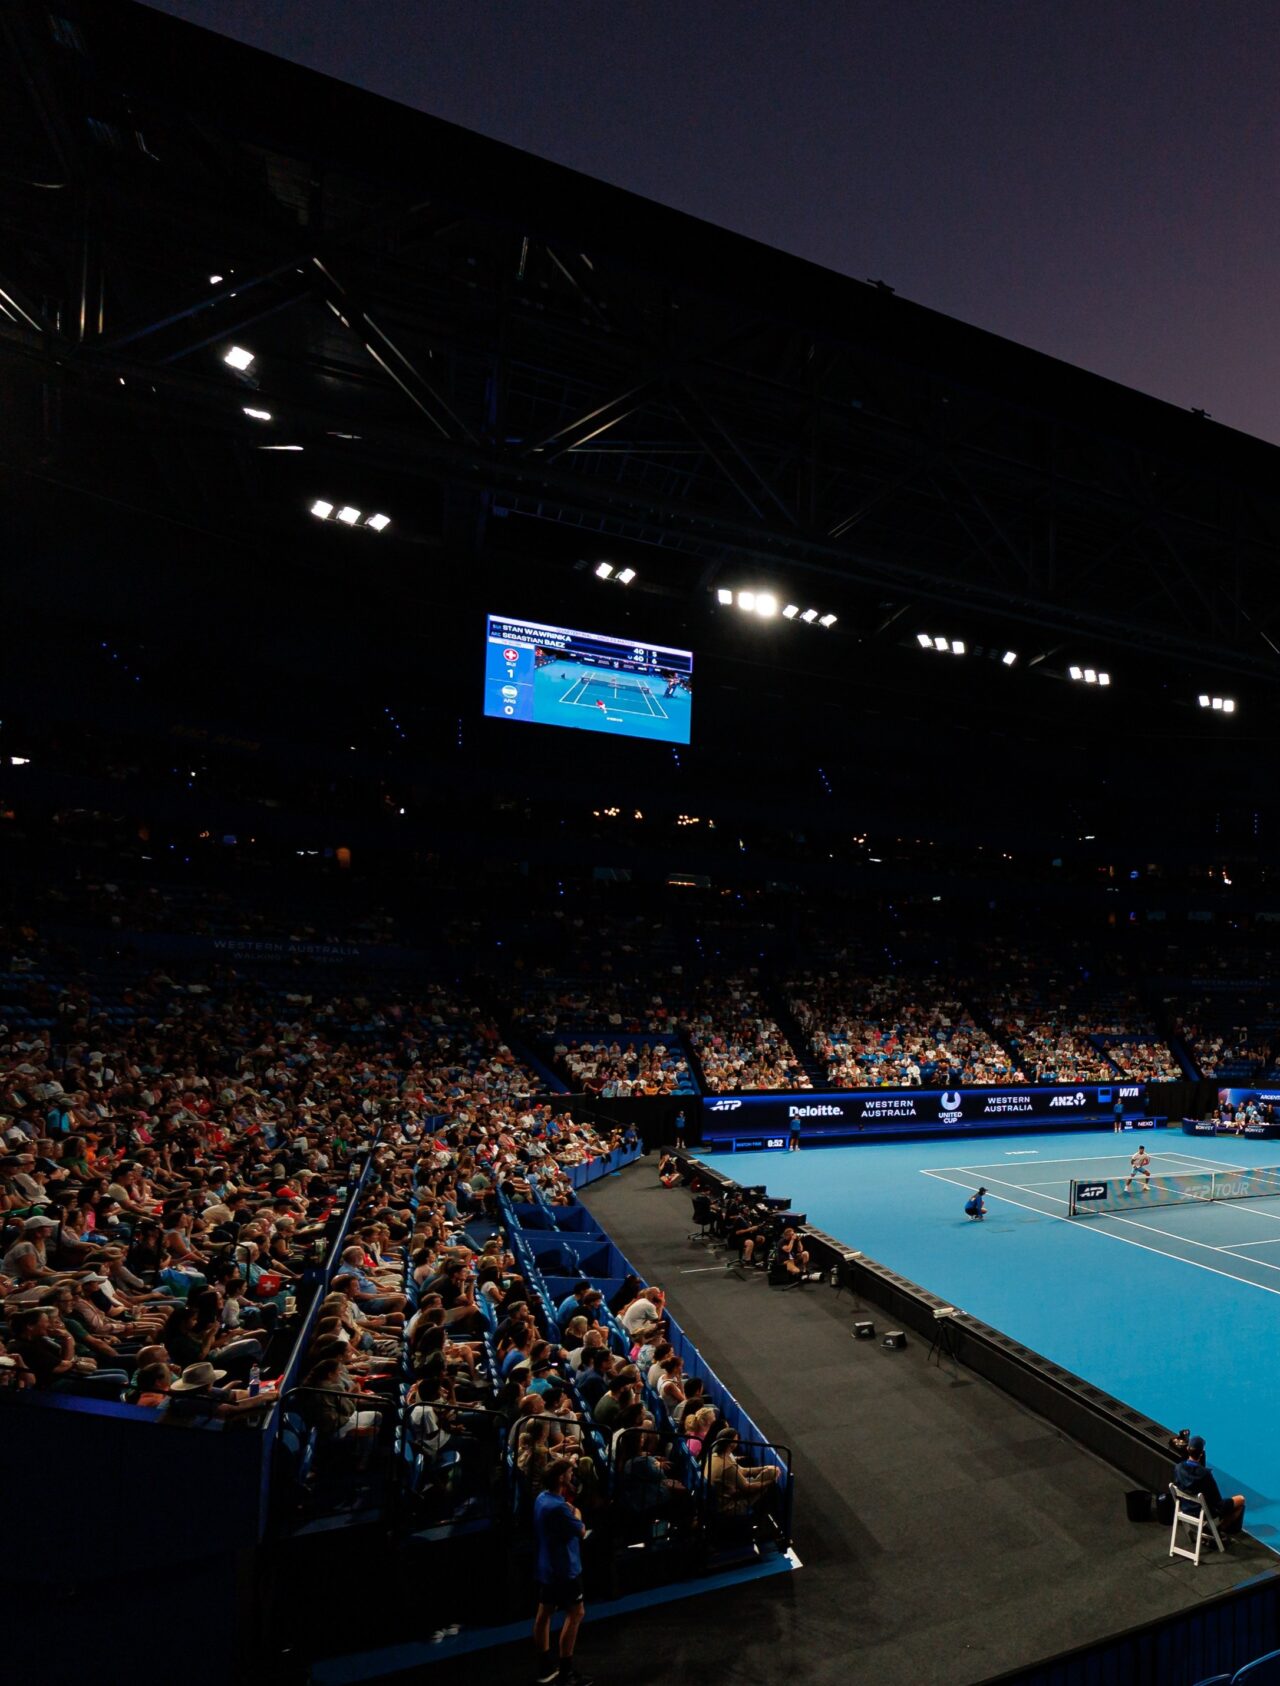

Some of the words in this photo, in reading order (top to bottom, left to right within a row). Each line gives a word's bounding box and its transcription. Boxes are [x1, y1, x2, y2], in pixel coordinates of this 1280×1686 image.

[502, 624, 524, 635] STAN
[524, 628, 572, 643] WAWRINKA
[502, 632, 544, 645] SEBASTIAN
[544, 639, 566, 649] BAEZ
[633, 647, 645, 656] 40
[633, 654, 645, 663] 40
[506, 669, 514, 679] 1
[504, 705, 514, 715] 0
[1119, 1087, 1139, 1097] WTA
[865, 1100, 914, 1109] WESTERN
[987, 1096, 1031, 1104] WESTERN
[1049, 1095, 1074, 1107] ANZ
[710, 1100, 742, 1111] ATP
[984, 1103, 1033, 1112] AUSTRALIA
[789, 1105, 844, 1117] Deloitte.
[861, 1108, 917, 1118] AUSTRALIA
[767, 1139, 784, 1147] 0:52
[1080, 1186, 1105, 1198] ATP
[1216, 1181, 1250, 1197] TOUR
